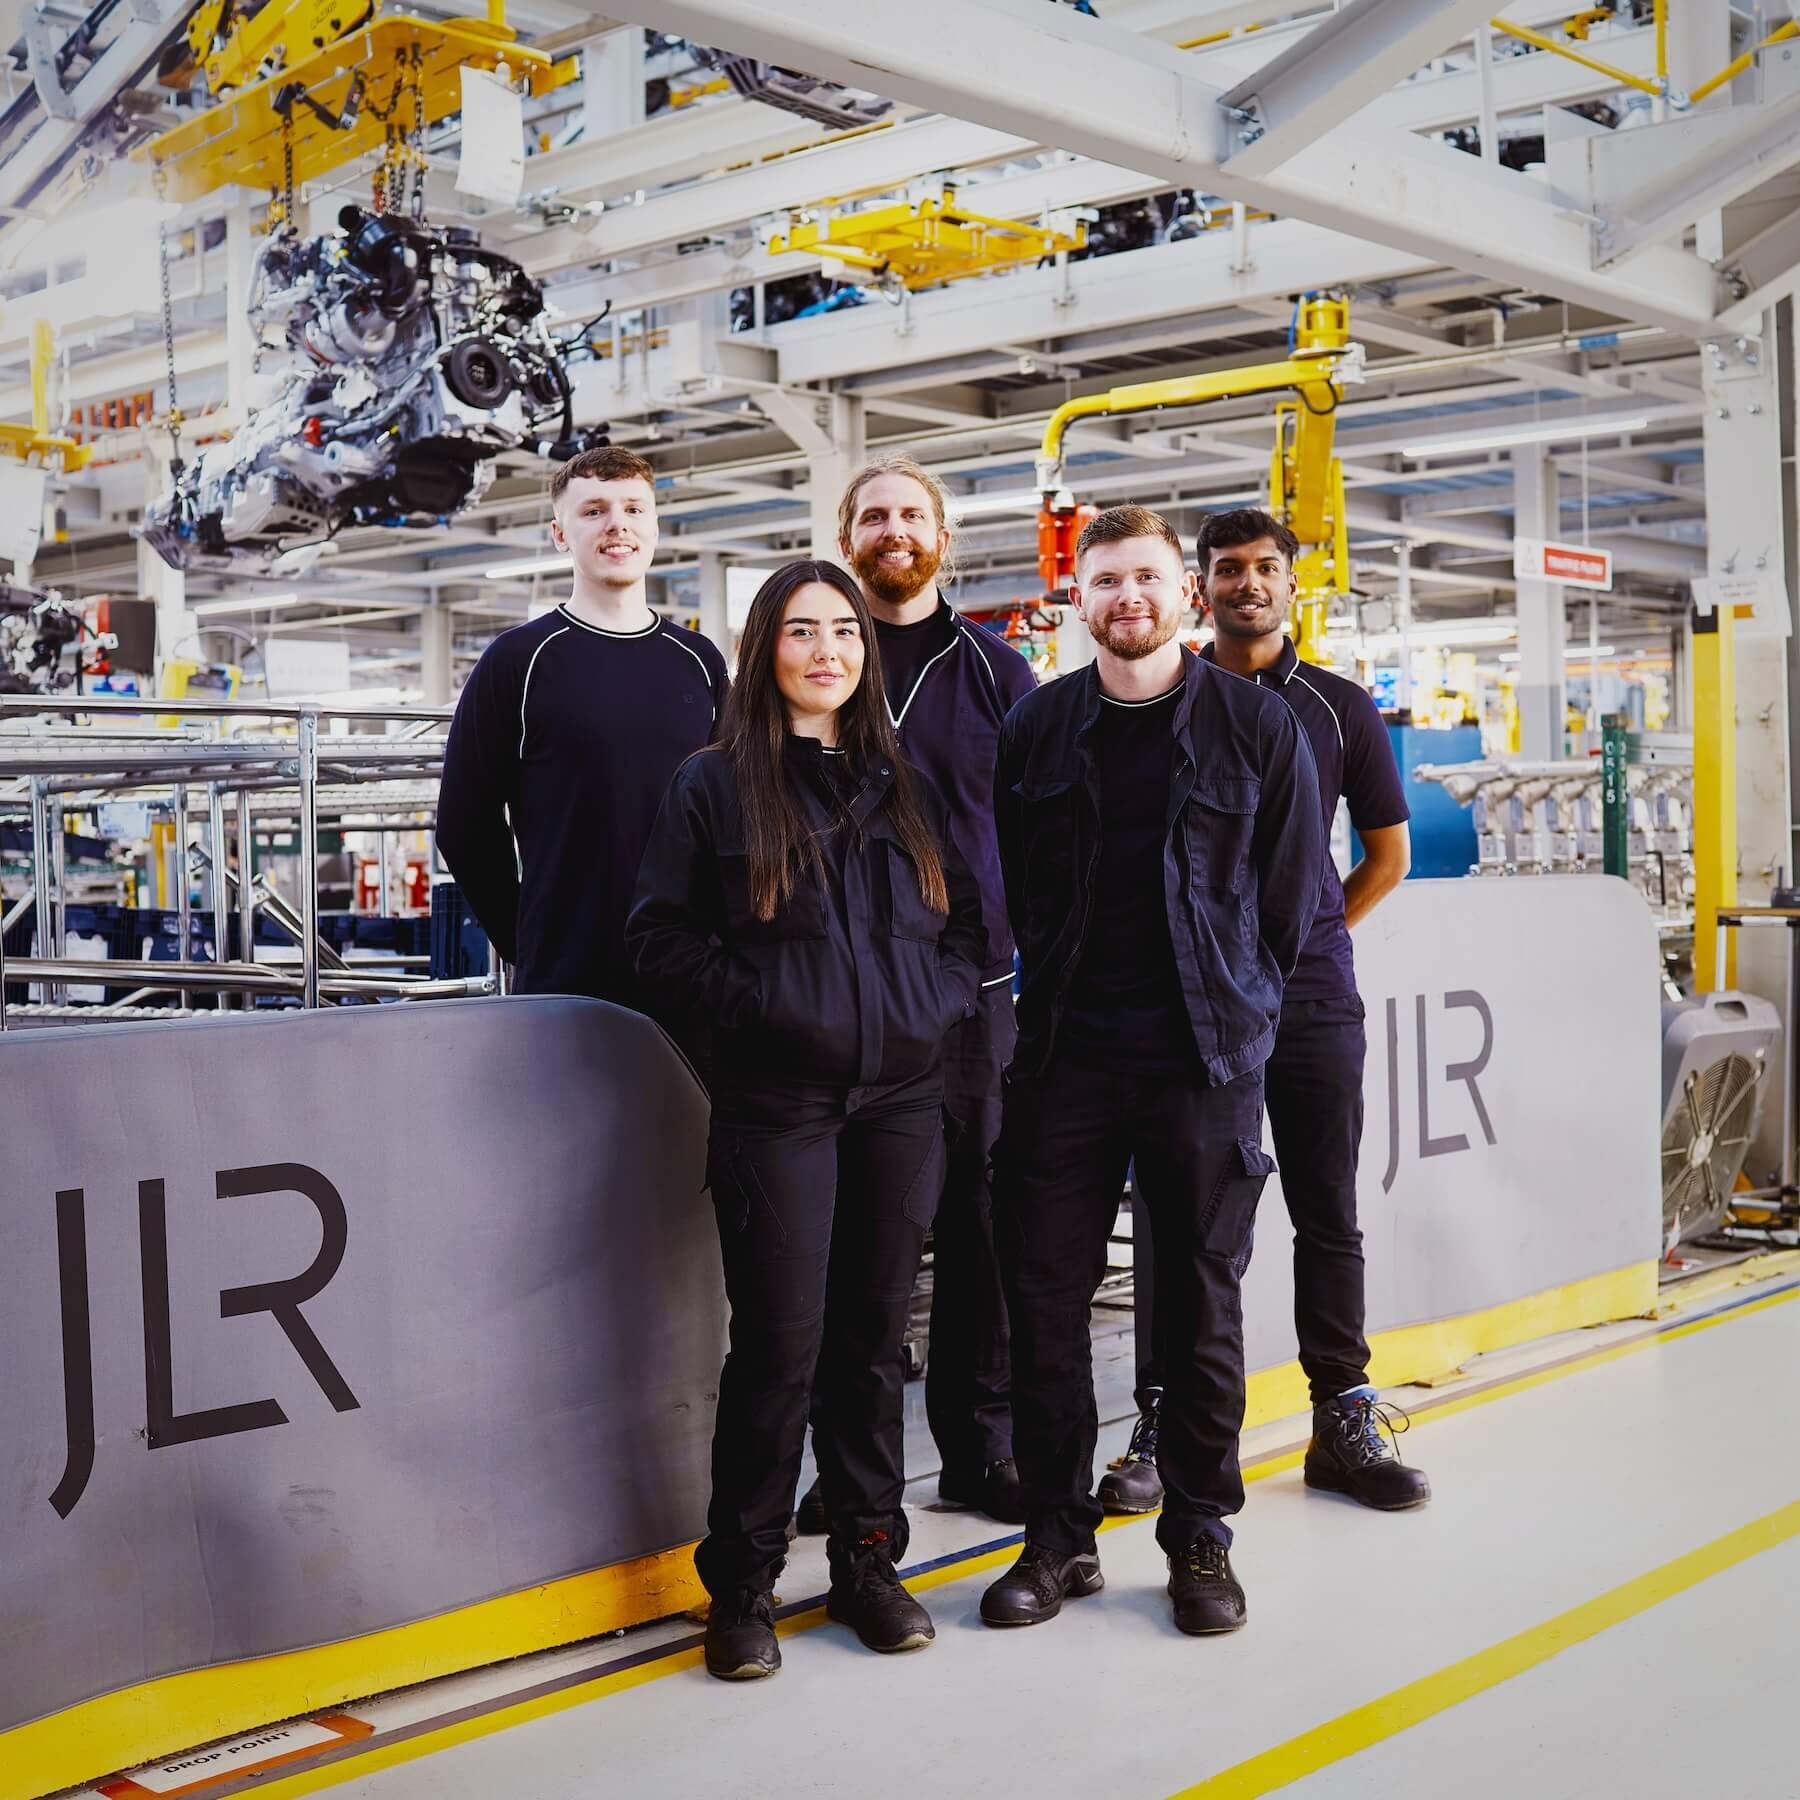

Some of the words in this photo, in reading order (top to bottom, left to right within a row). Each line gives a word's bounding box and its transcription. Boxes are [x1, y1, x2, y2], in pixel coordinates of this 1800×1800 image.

[1382, 989, 1498, 1195] JLR
[48, 1162, 361, 1520] JLR
[163, 1753, 222, 1773] DROP
[227, 1731, 291, 1754] POINT
